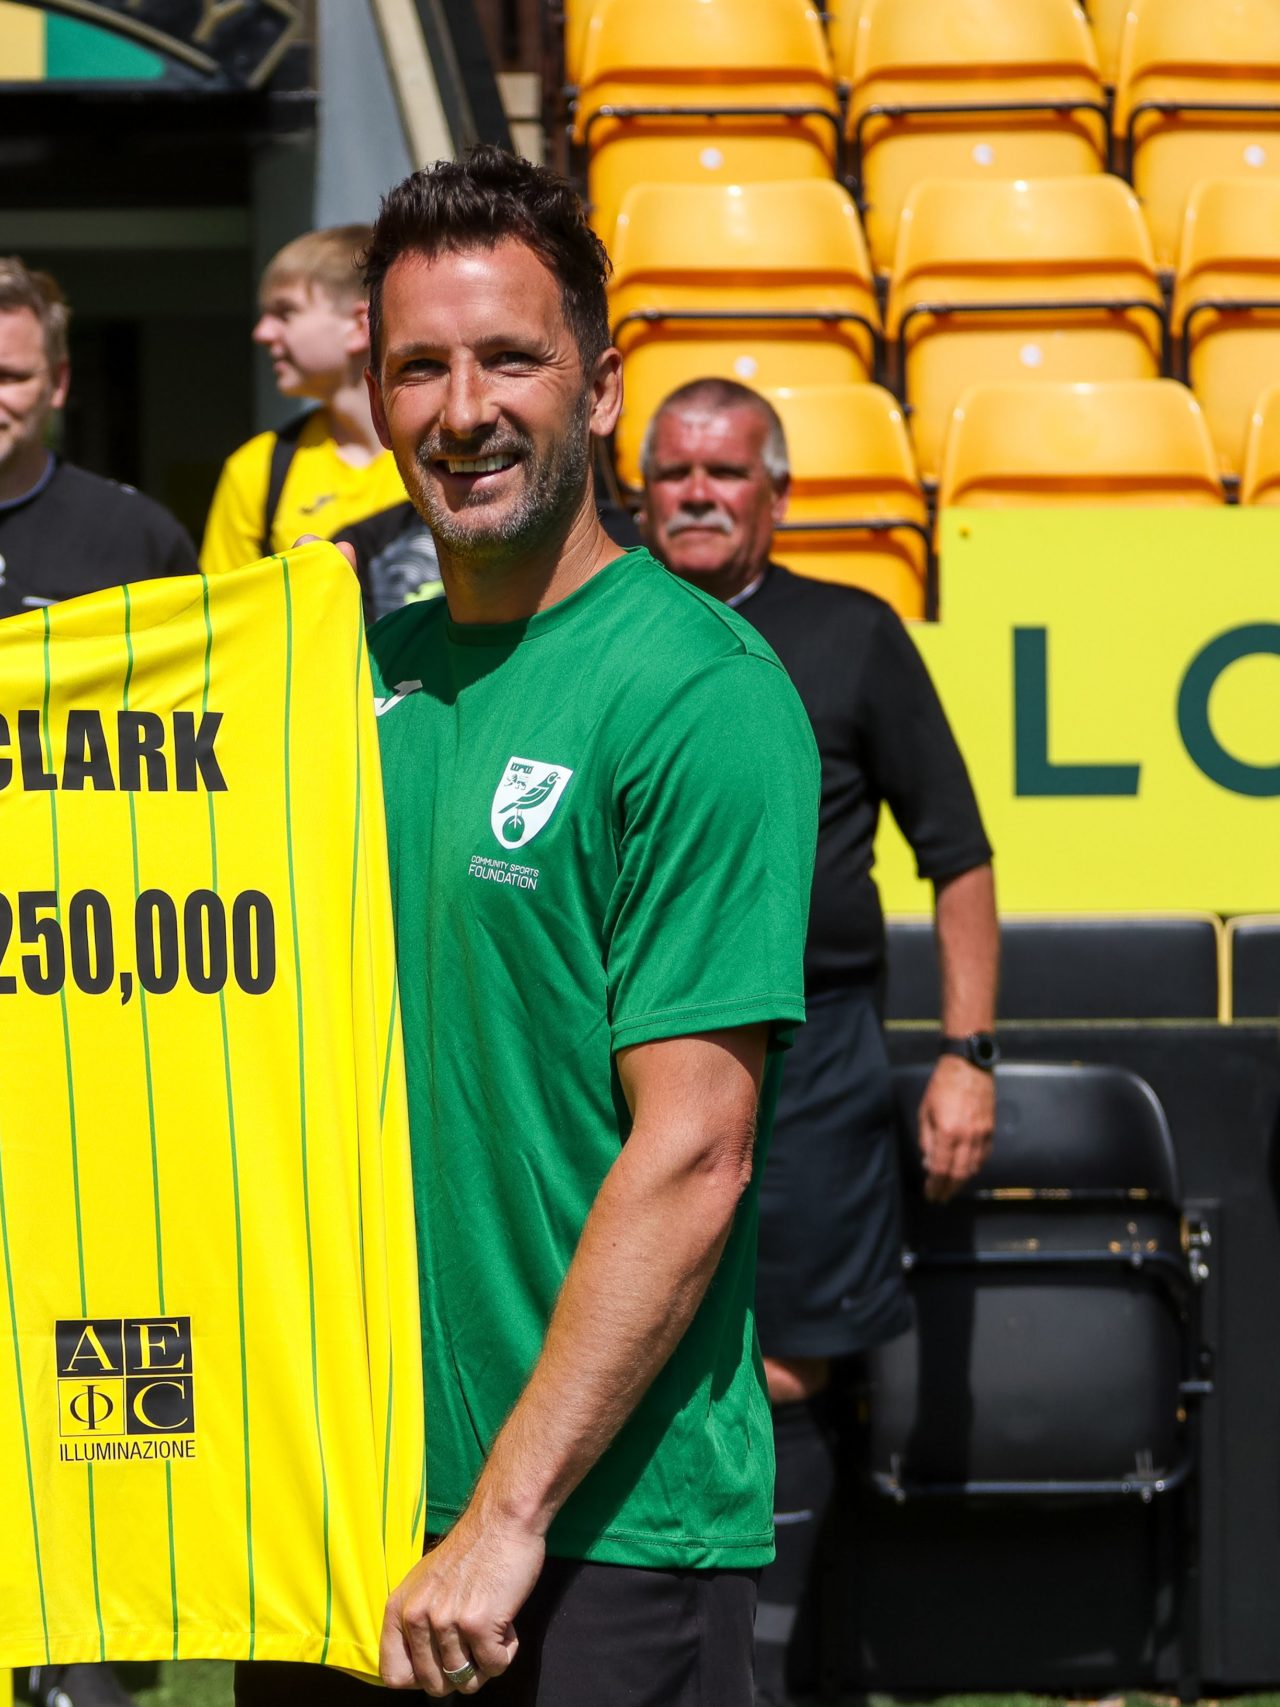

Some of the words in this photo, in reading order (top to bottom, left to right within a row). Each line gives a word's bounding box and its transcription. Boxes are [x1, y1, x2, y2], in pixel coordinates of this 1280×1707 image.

[468, 863, 538, 891] FOUNDATION
[471, 854, 509, 870] COMMUNITY
[509, 863, 540, 878] SPORTS
[60, 1440, 195, 1461] ILLUMINAZIONE
